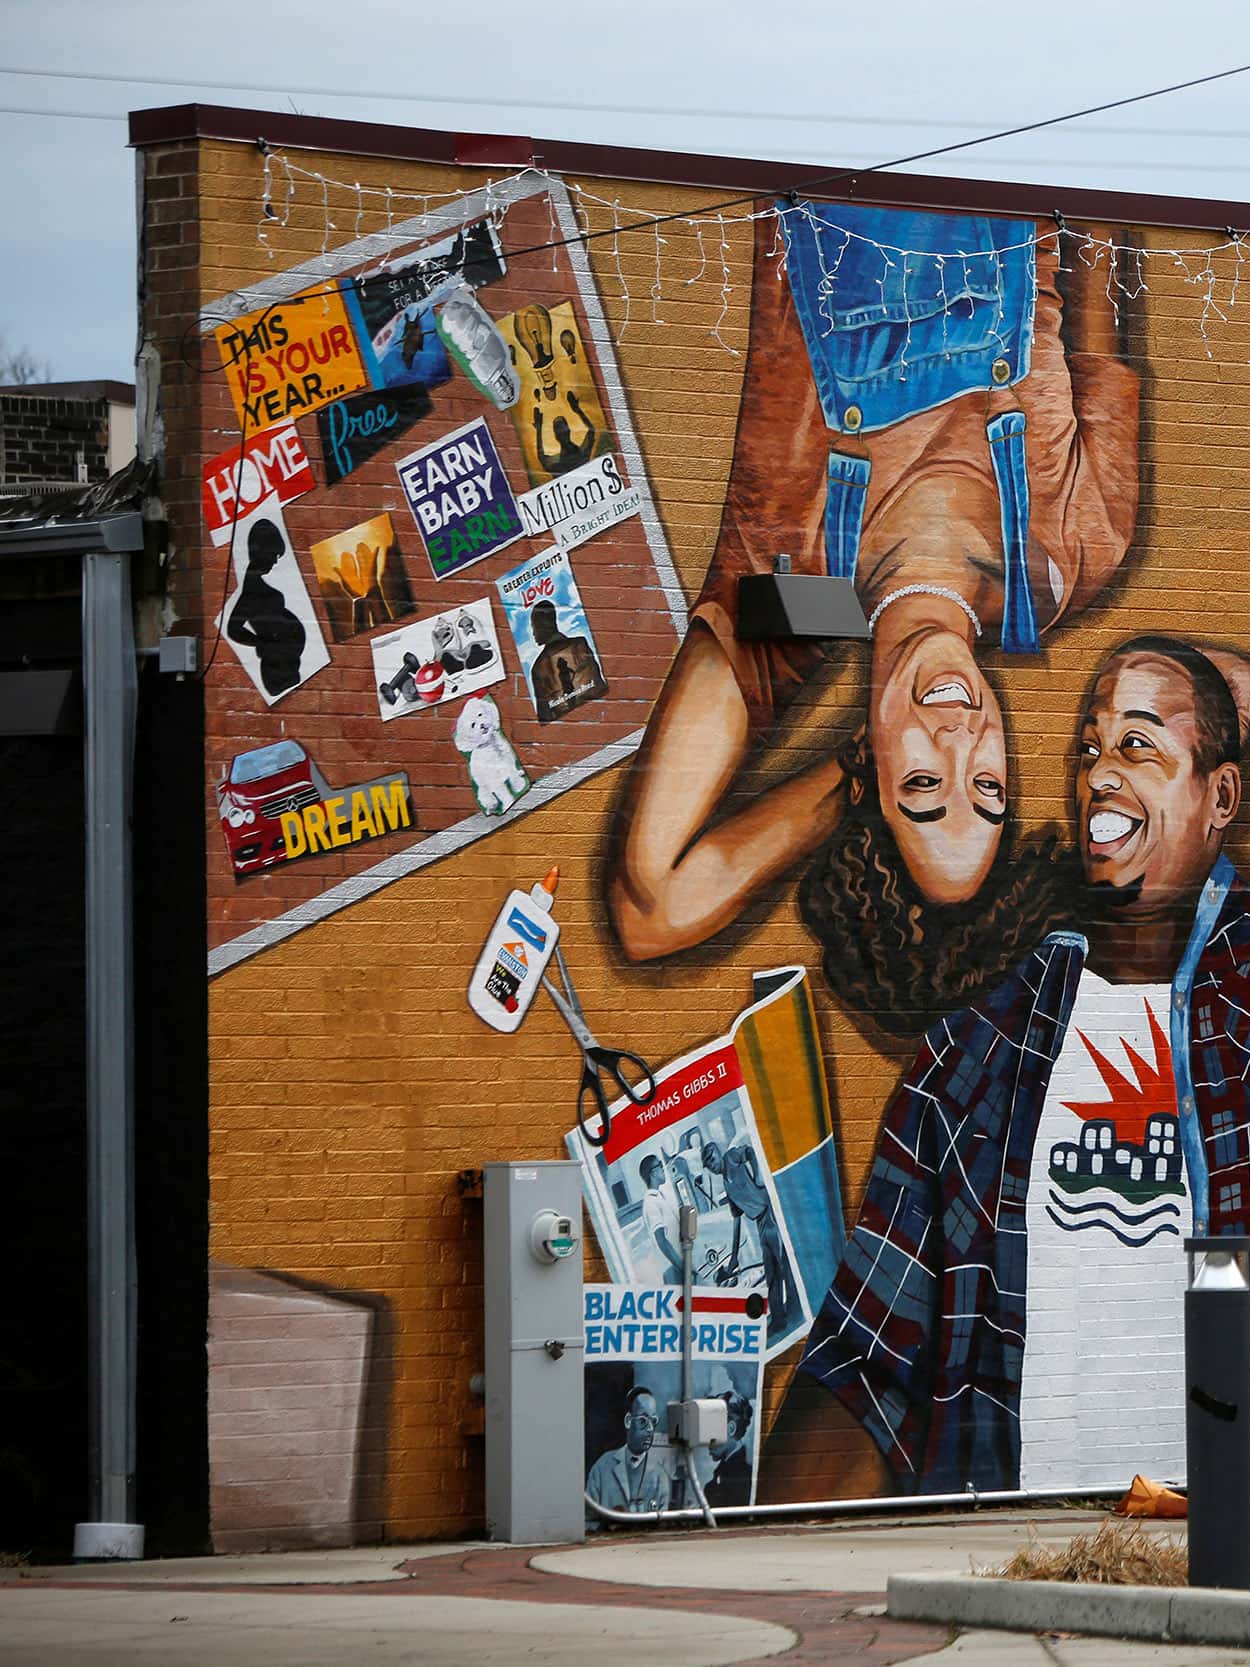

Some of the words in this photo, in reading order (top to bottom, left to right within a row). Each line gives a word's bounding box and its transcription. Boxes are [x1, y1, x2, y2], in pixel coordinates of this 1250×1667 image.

[222, 314, 289, 364] THIS
[237, 360, 267, 397] IS
[269, 324, 353, 382] YOUR
[206, 428, 310, 519] HOME
[401, 434, 487, 502] EARN
[416, 467, 496, 536] BABY
[426, 504, 519, 573] EARN.
[521, 576, 555, 609] LOVE
[279, 780, 411, 859] DREAM
[636, 1090, 681, 1126] THOMAS
[682, 1069, 716, 1099] GIBBS
[584, 1290, 674, 1320] BLACK
[584, 1323, 762, 1354] ENTERPRISE
